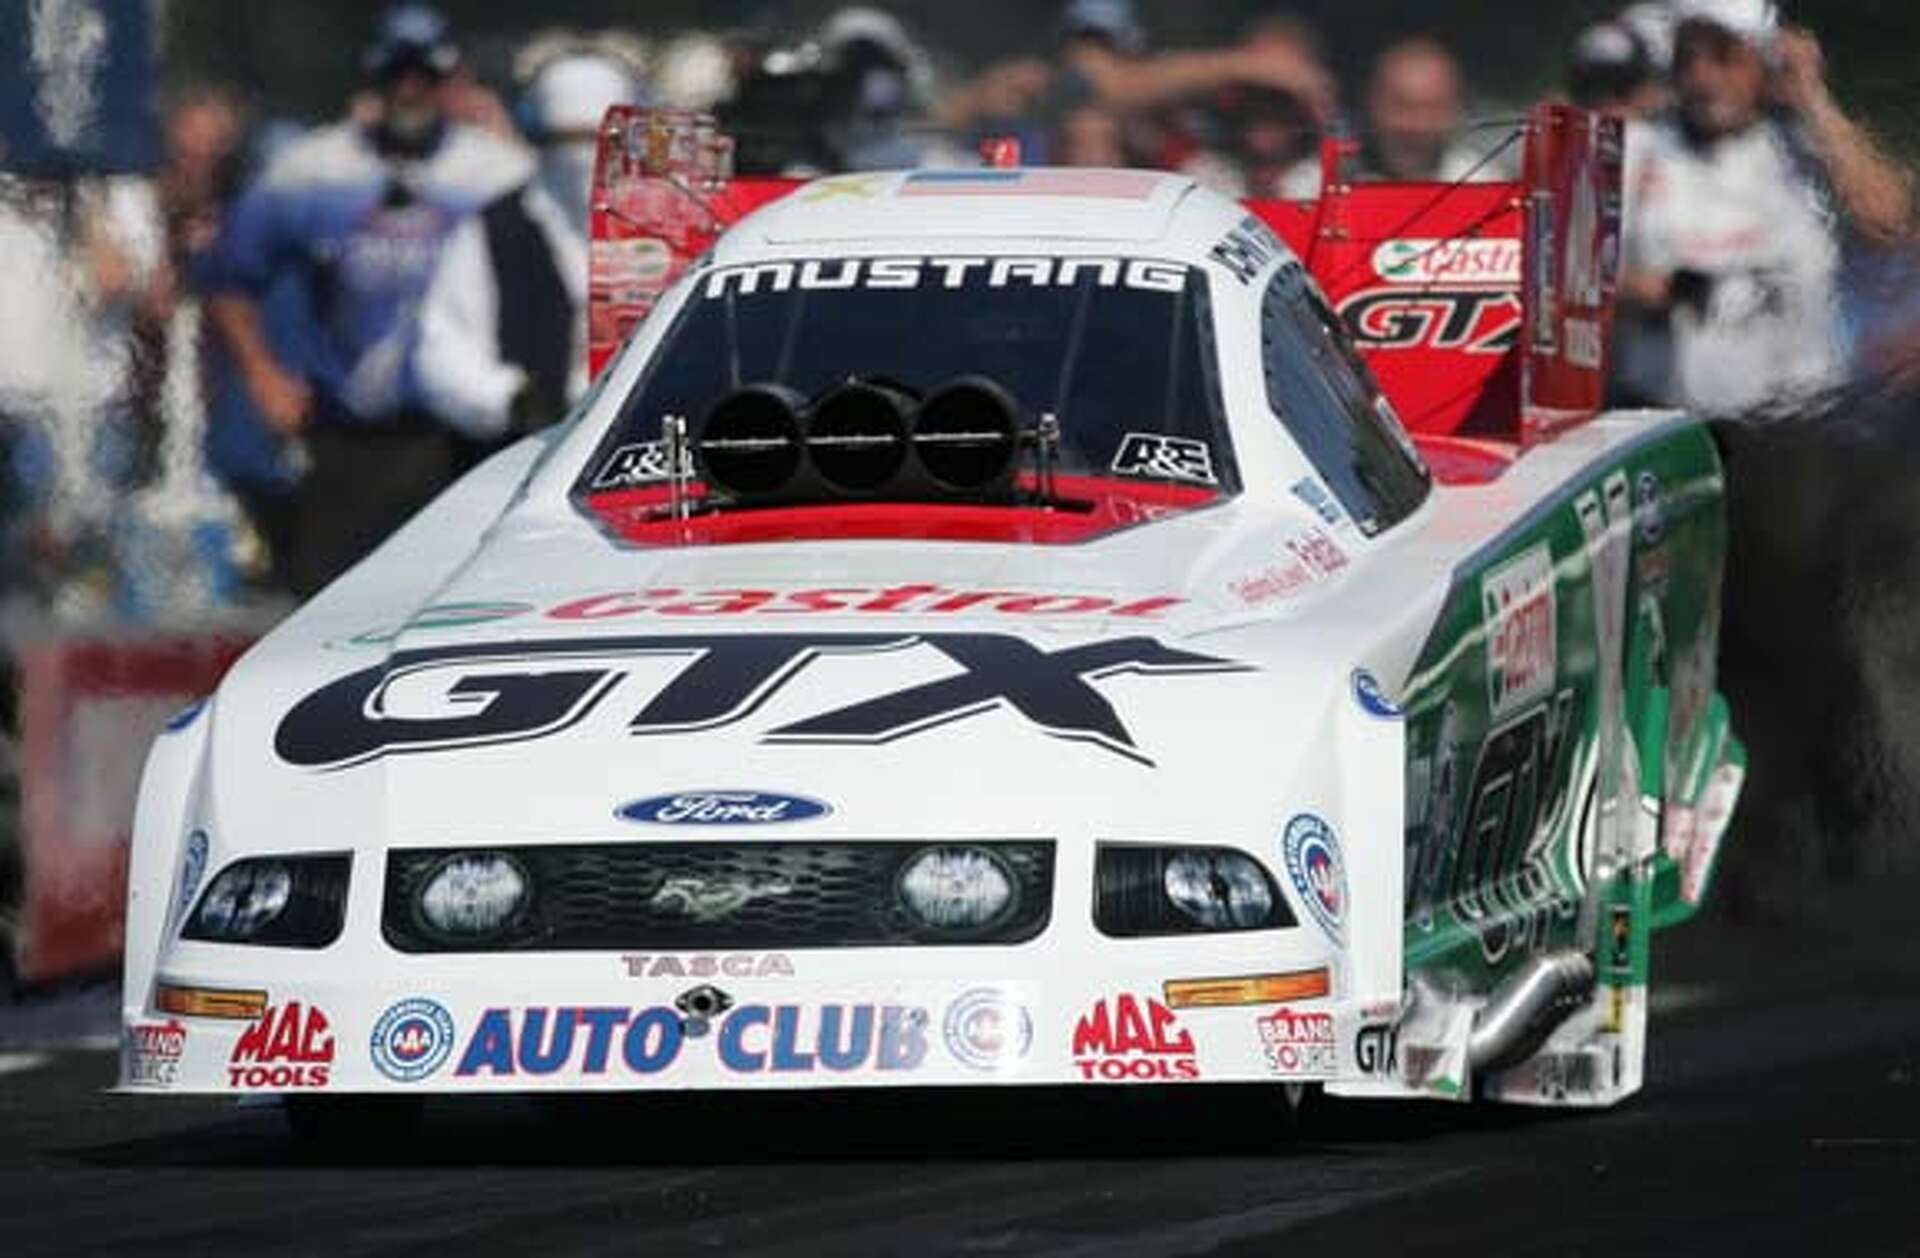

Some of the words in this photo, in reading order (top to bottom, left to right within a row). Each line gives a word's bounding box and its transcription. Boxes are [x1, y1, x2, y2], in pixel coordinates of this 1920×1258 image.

[706, 256, 1188, 299] MUSTANG
[546, 583, 1188, 620] Castrol
[275, 633, 1257, 768] GTX
[656, 797, 791, 822] Ford
[622, 954, 796, 977] TASCA
[231, 1002, 334, 1063] MAC
[455, 1005, 686, 1076] AUTO
[718, 1004, 930, 1073] CLUB
[1073, 993, 1195, 1055] MAC
[229, 1067, 330, 1087] TOOLS
[1074, 1059, 1198, 1080] TOOLS
